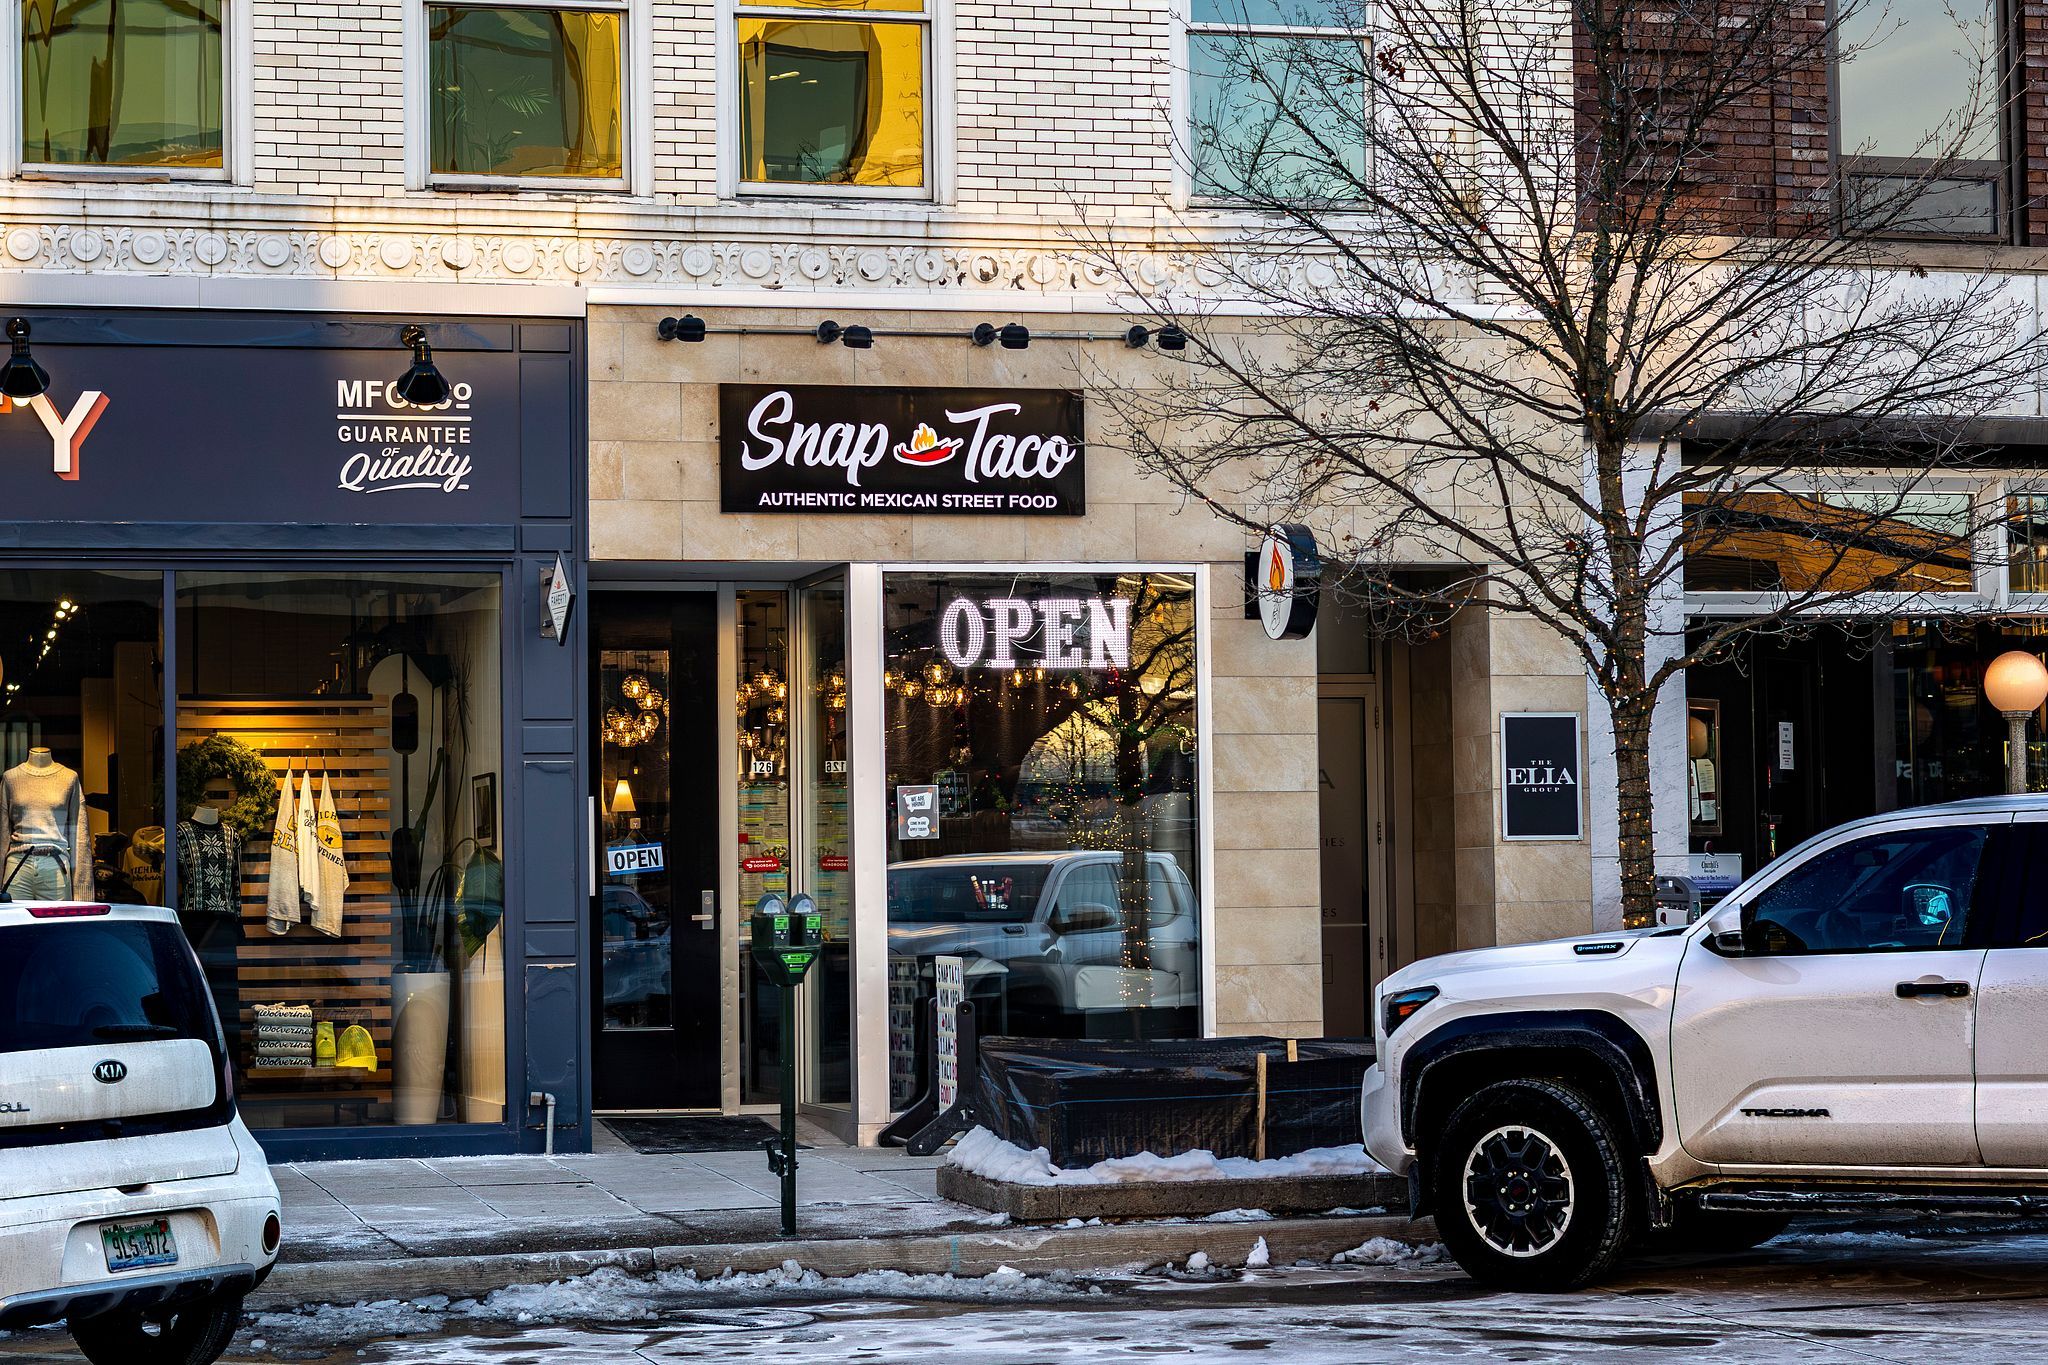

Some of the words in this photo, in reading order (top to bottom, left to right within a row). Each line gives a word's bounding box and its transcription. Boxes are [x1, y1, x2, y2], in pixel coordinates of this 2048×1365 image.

[8, 390, 110, 480] Y
[337, 425, 471, 444] GUARANTEE
[741, 391, 888, 487] Snap
[944, 403, 1076, 483] Taco
[381, 447, 401, 457] OF
[338, 444, 473, 493] Quality
[759, 492, 857, 507] AUTHENTIC
[860, 493, 939, 508] MEXICAN
[942, 494, 1004, 509] STREET
[1009, 495, 1058, 509] FOOD
[941, 598, 1131, 669] OPEN
[753, 762, 772, 773] 126
[1507, 767, 1576, 786] ELIA
[614, 849, 659, 870] OPEN
[100, 1063, 124, 1079] KIA
[1740, 1108, 1831, 1117] TACOMA
